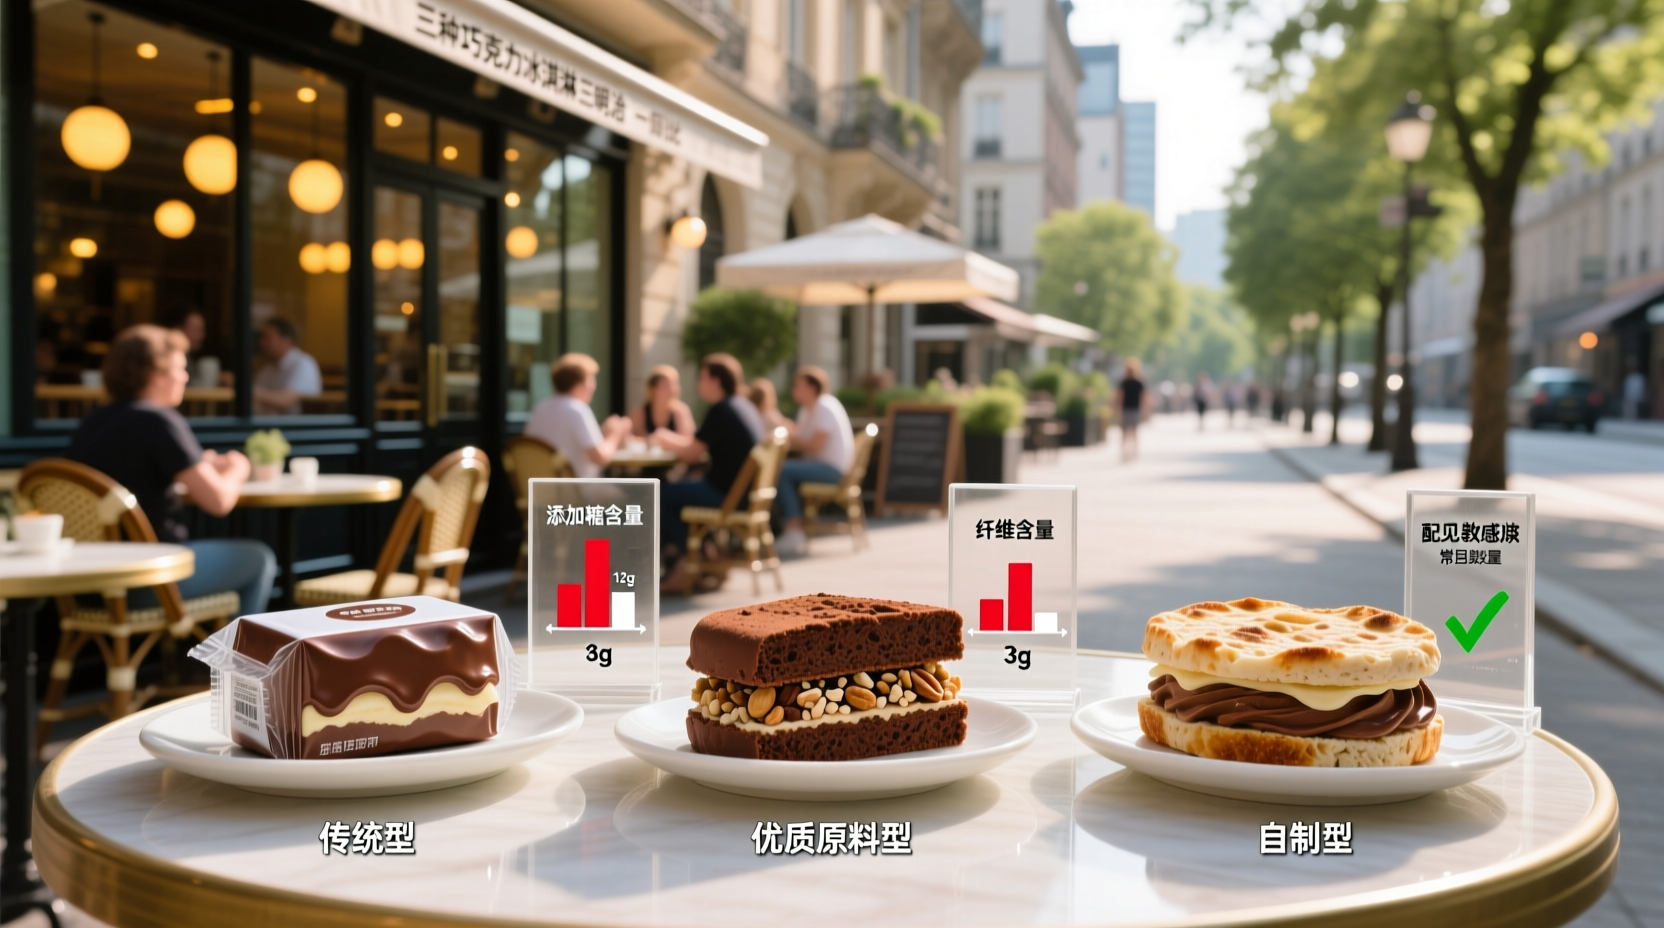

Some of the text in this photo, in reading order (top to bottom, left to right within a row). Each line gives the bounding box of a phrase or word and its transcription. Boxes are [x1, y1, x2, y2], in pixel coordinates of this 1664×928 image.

[546, 504, 644, 526] 添加糖含量
[975, 518, 1054, 540] 纤维含量
[612, 571, 636, 587] 12g
[585, 643, 613, 668] 3g
[1004, 645, 1031, 670] 3g
